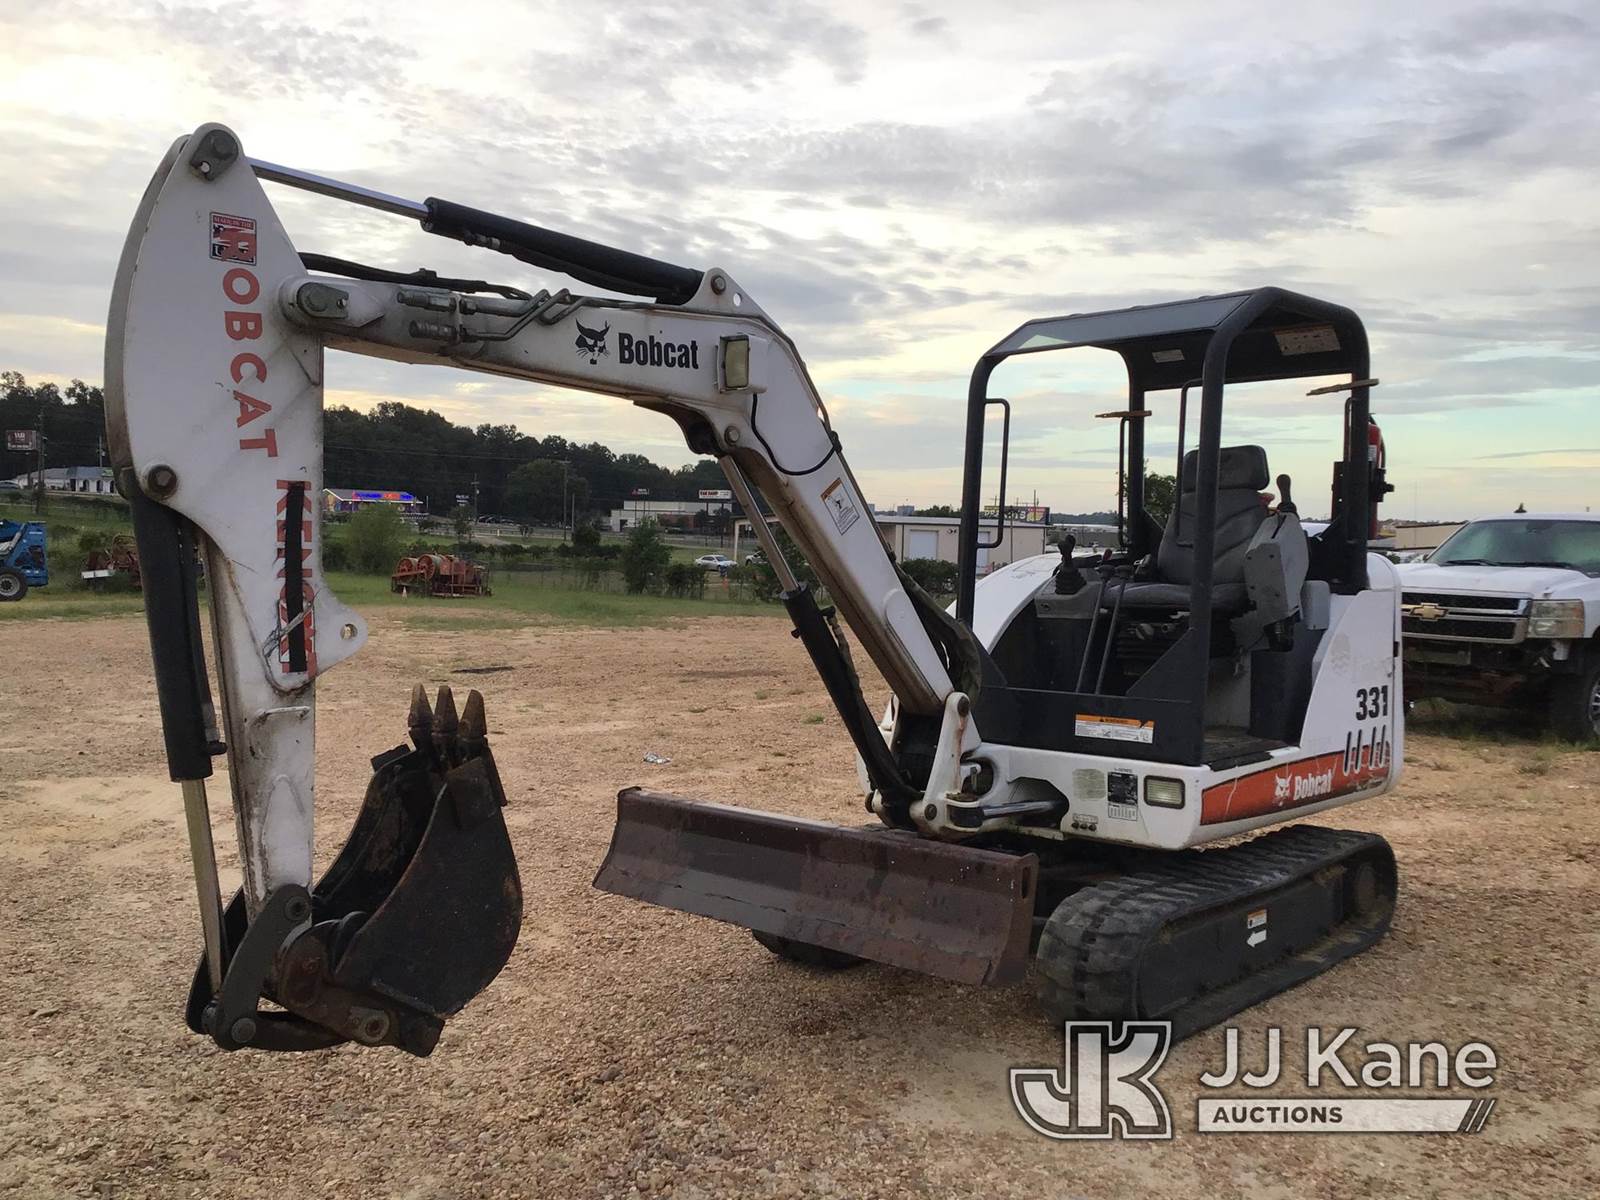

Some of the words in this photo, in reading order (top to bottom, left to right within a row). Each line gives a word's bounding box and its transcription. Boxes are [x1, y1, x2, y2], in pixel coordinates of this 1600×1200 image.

[618, 332, 699, 369] Bobcat
[1356, 685, 1389, 720] 331
[1293, 769, 1334, 800] Bobcat
